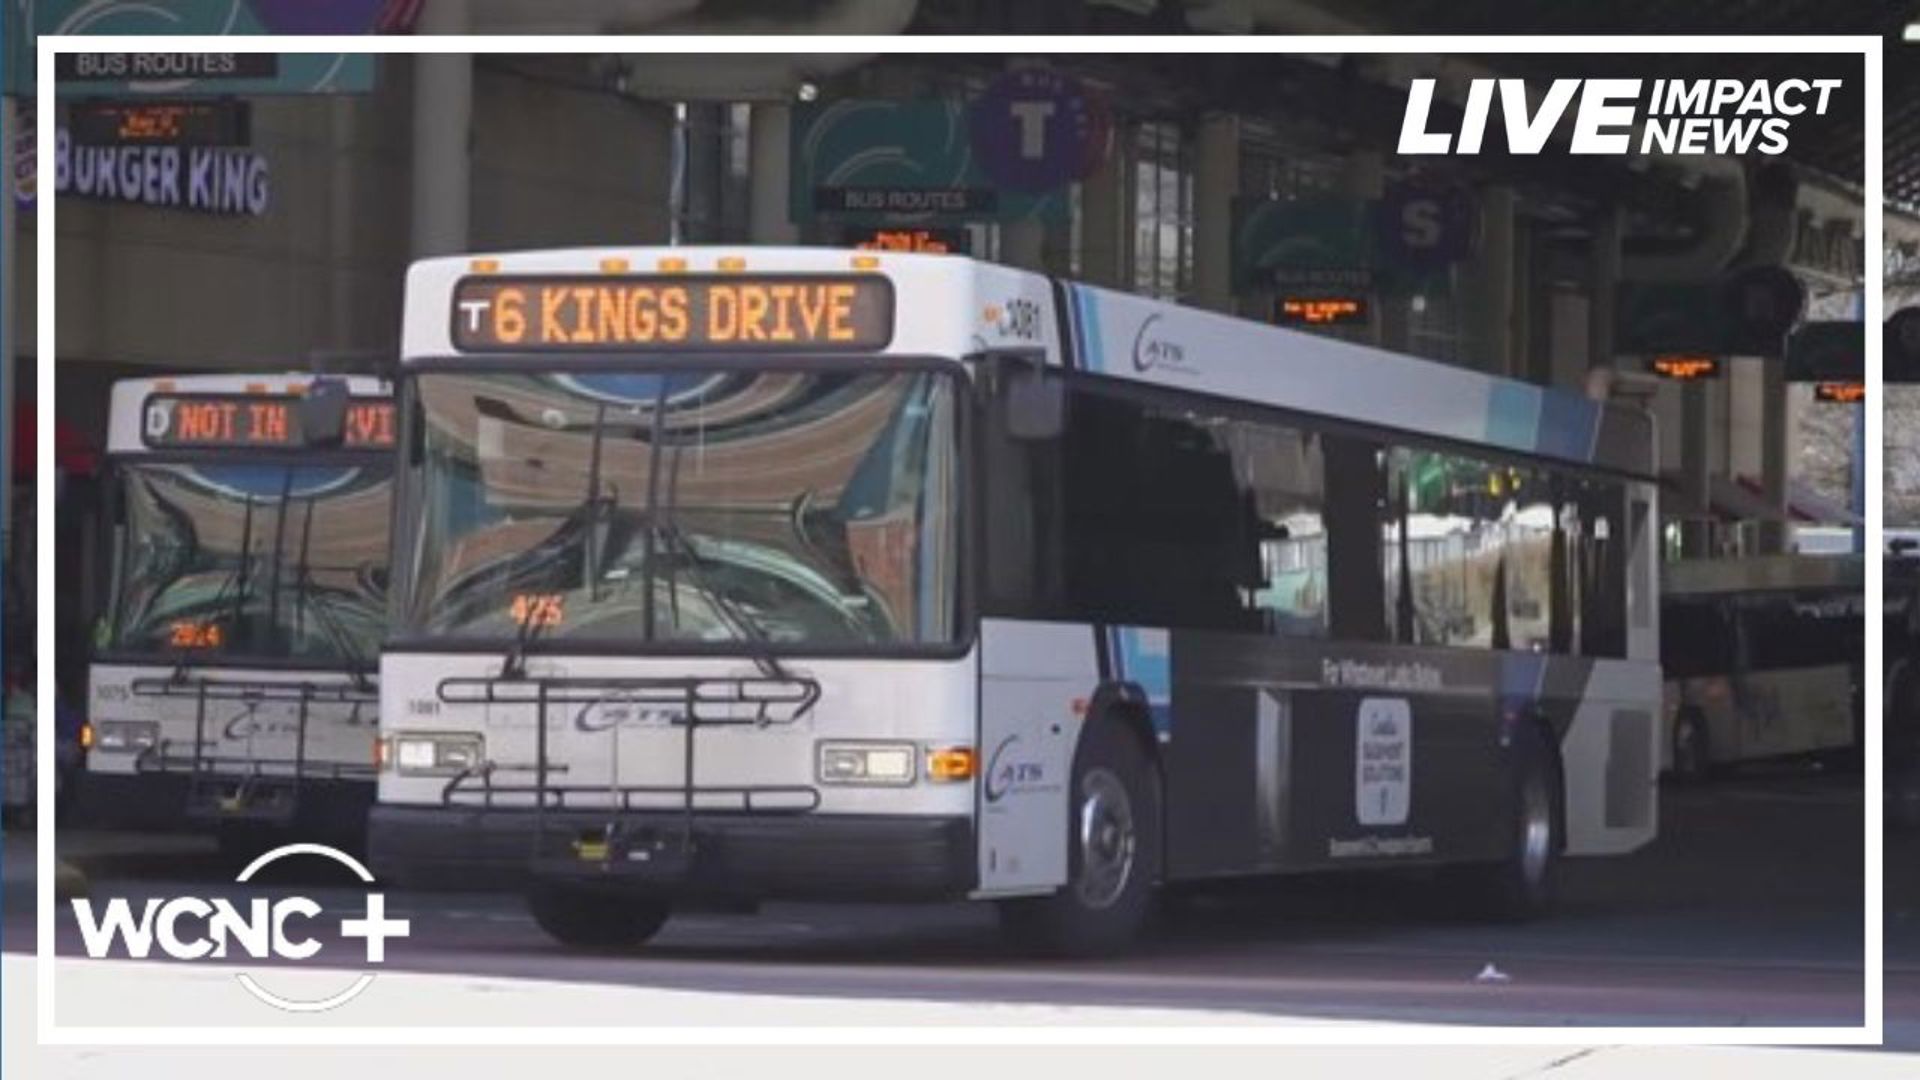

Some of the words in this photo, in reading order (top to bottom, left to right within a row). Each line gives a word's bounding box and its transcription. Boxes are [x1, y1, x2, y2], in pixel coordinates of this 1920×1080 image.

[76, 53, 126, 75] BUS
[133, 53, 235, 74] ROUTES
[1011, 102, 1055, 158] T
[55, 128, 179, 203] BURGER
[188, 147, 268, 215] KING
[1402, 201, 1441, 246] S
[460, 302, 490, 332] T
[494, 289, 526, 343] 6
[541, 286, 688, 343] KINGS
[709, 285, 855, 341] DRIVE
[175, 402, 238, 442] NOT
[249, 403, 289, 441] IN
